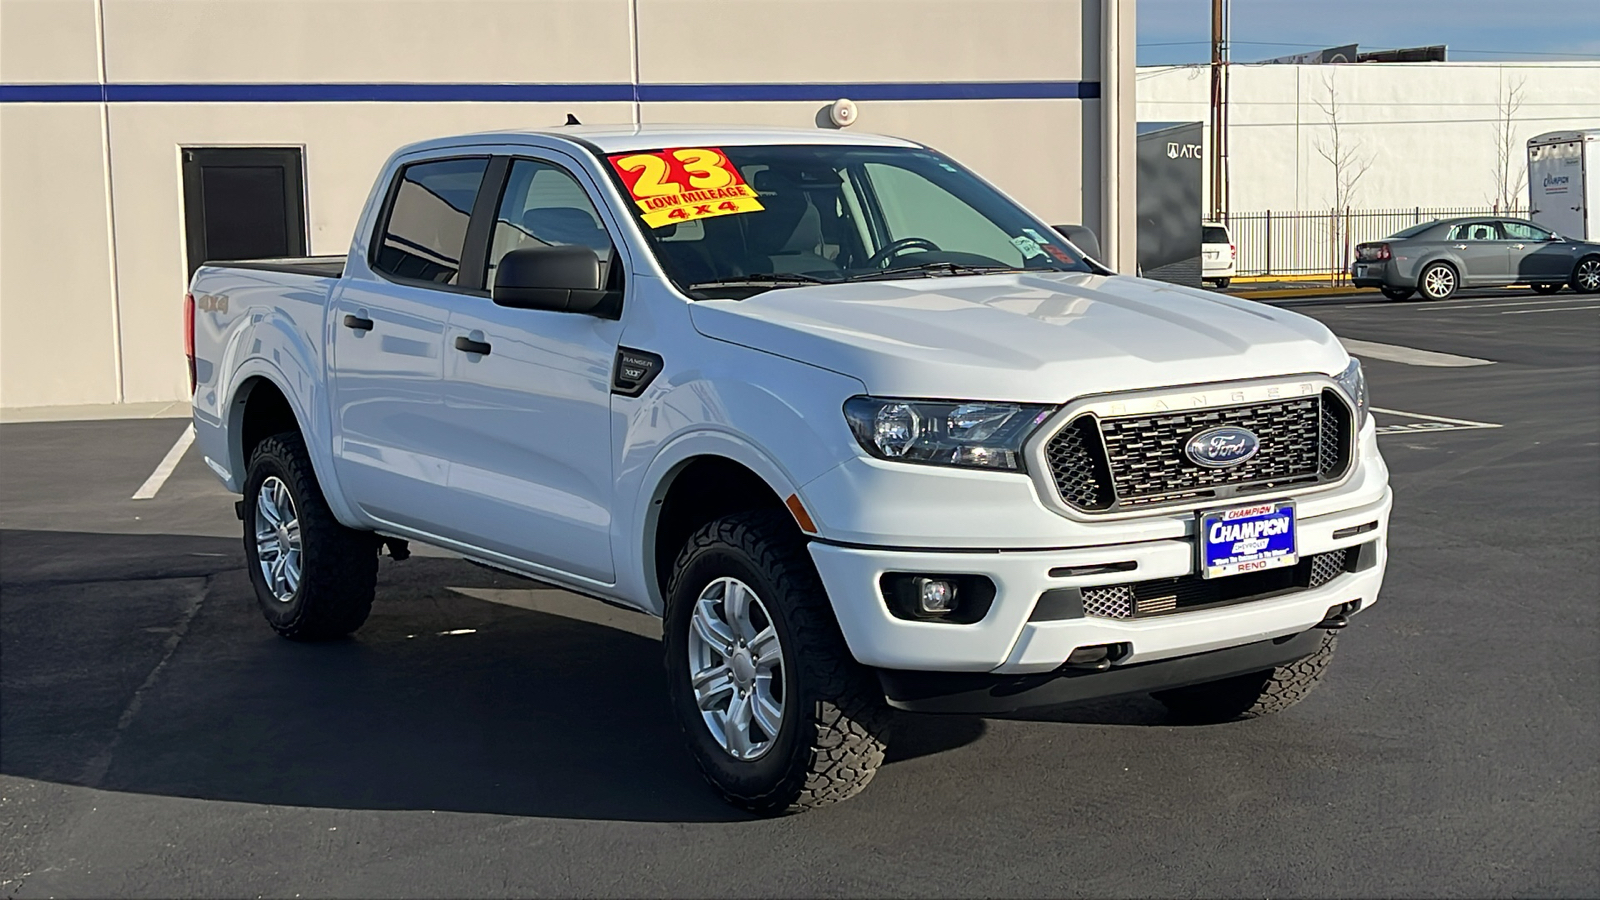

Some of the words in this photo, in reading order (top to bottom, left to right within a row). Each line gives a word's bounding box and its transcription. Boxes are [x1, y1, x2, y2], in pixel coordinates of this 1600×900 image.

[616, 149, 737, 198] 23
[645, 194, 681, 210] LOW
[680, 186, 748, 203] MILEAGE
[623, 356, 652, 366] RANGER
[1111, 383, 1314, 414] RANGER
[1208, 435, 1246, 458] Ford
[1228, 505, 1272, 519] CHAMPION
[1209, 517, 1290, 544] CHAMPION
[1235, 541, 1266, 551] CHEVROLET
[1238, 561, 1267, 572] RENO
